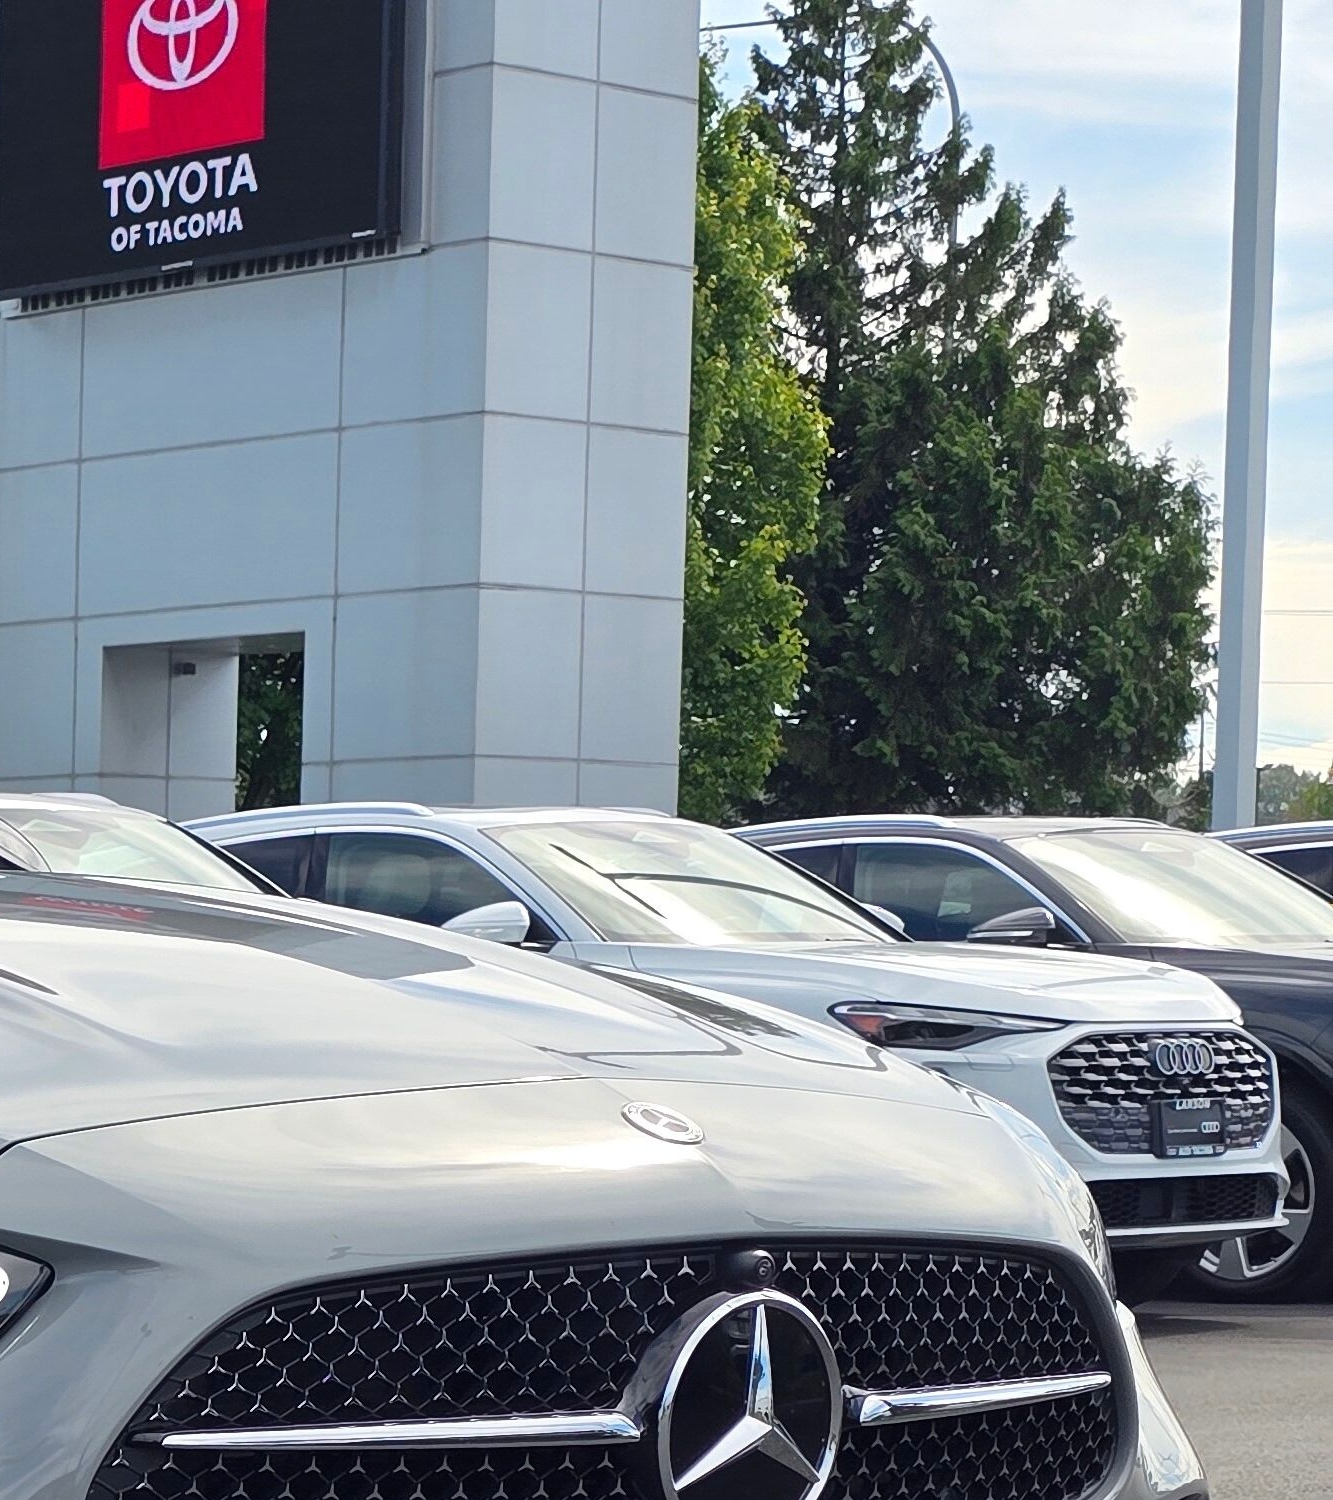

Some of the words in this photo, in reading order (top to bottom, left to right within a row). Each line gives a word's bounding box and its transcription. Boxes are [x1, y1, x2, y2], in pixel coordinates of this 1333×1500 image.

[103, 153, 257, 217] TOYOTA
[111, 224, 141, 251] OF
[145, 207, 244, 246] TACOMA
